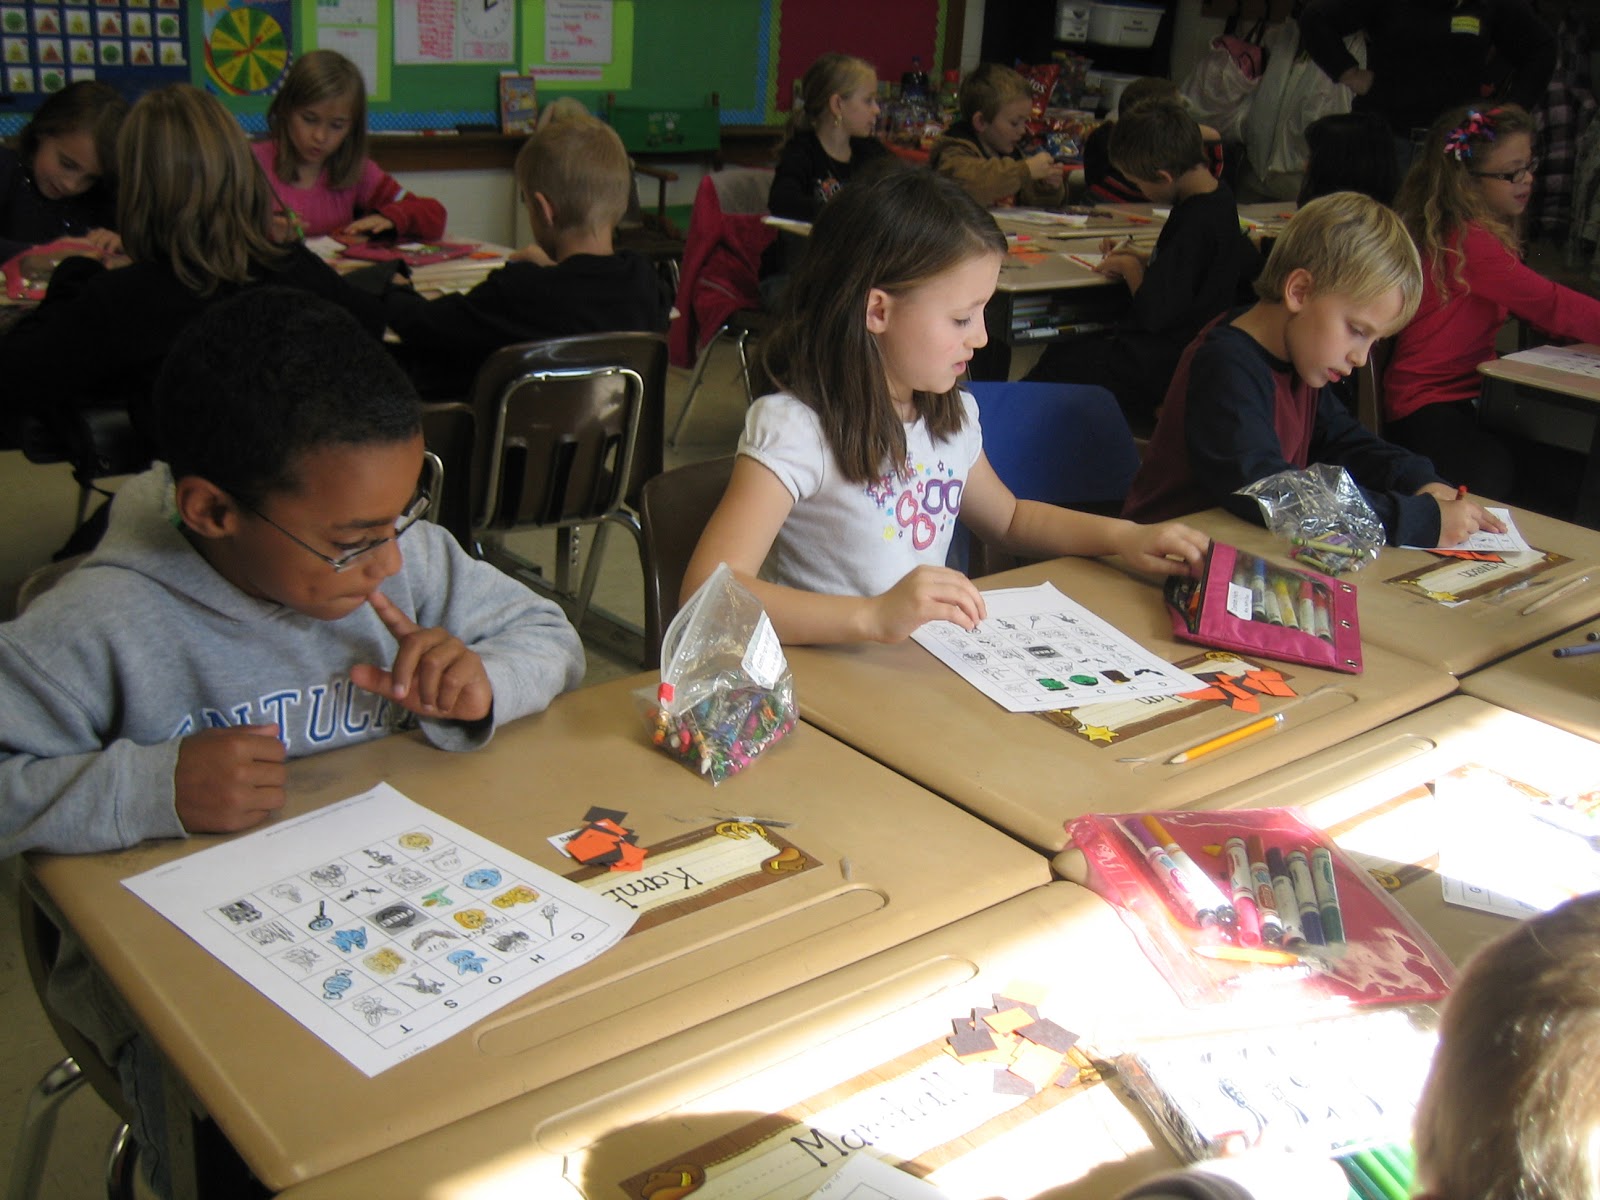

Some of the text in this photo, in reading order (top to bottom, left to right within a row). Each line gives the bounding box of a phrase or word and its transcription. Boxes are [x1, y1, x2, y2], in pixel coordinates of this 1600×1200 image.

[400, 932, 585, 1034] G H O S T
